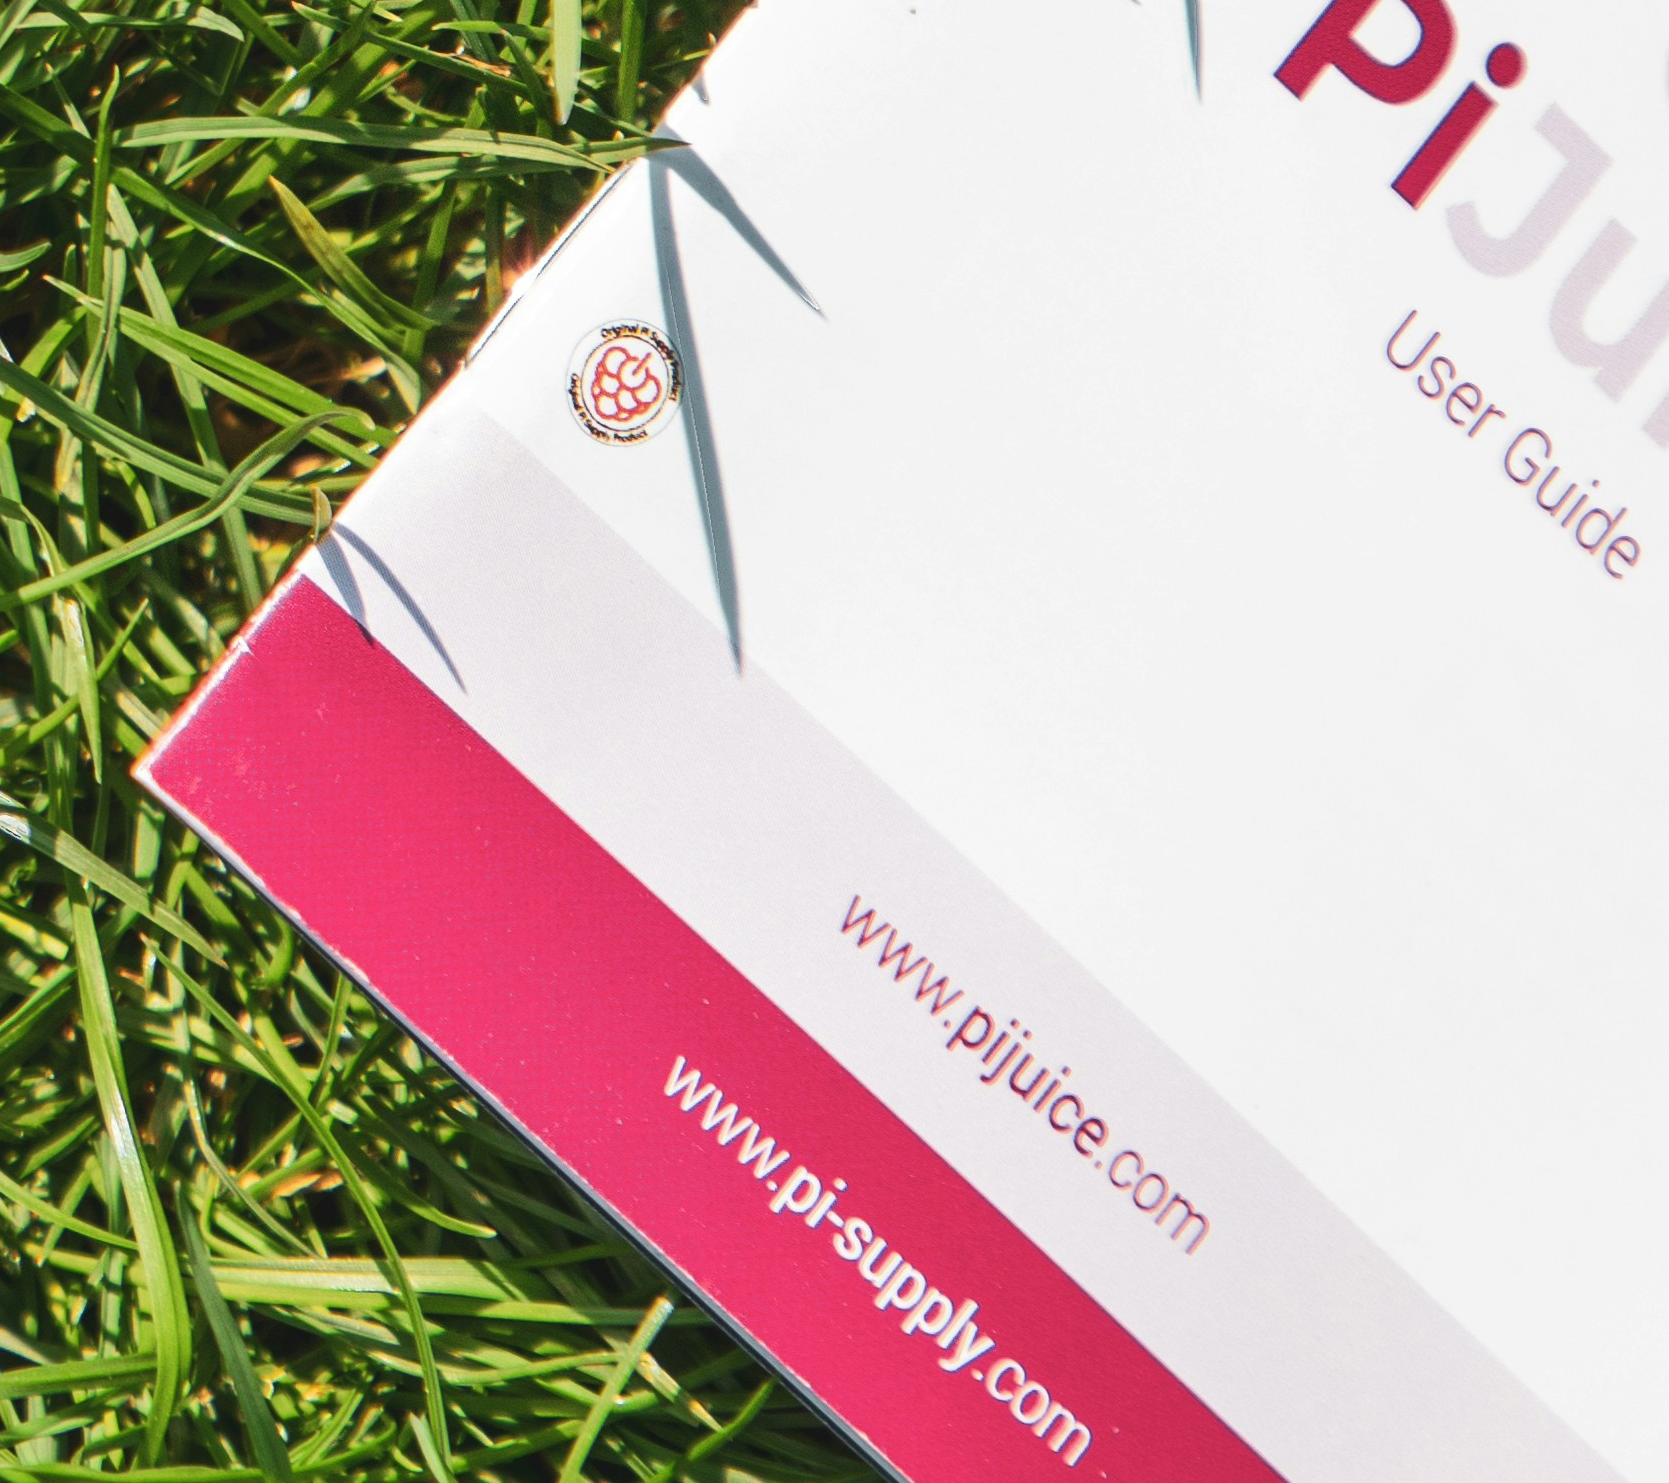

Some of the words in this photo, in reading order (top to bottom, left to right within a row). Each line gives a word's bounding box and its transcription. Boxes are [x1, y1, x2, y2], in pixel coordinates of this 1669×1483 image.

[1385, 308, 1507, 438] User
[1504, 426, 1642, 580] Guide
[840, 893, 1211, 1256] www.pijuice.com
[663, 1054, 1094, 1468] www.pi-supply.com
